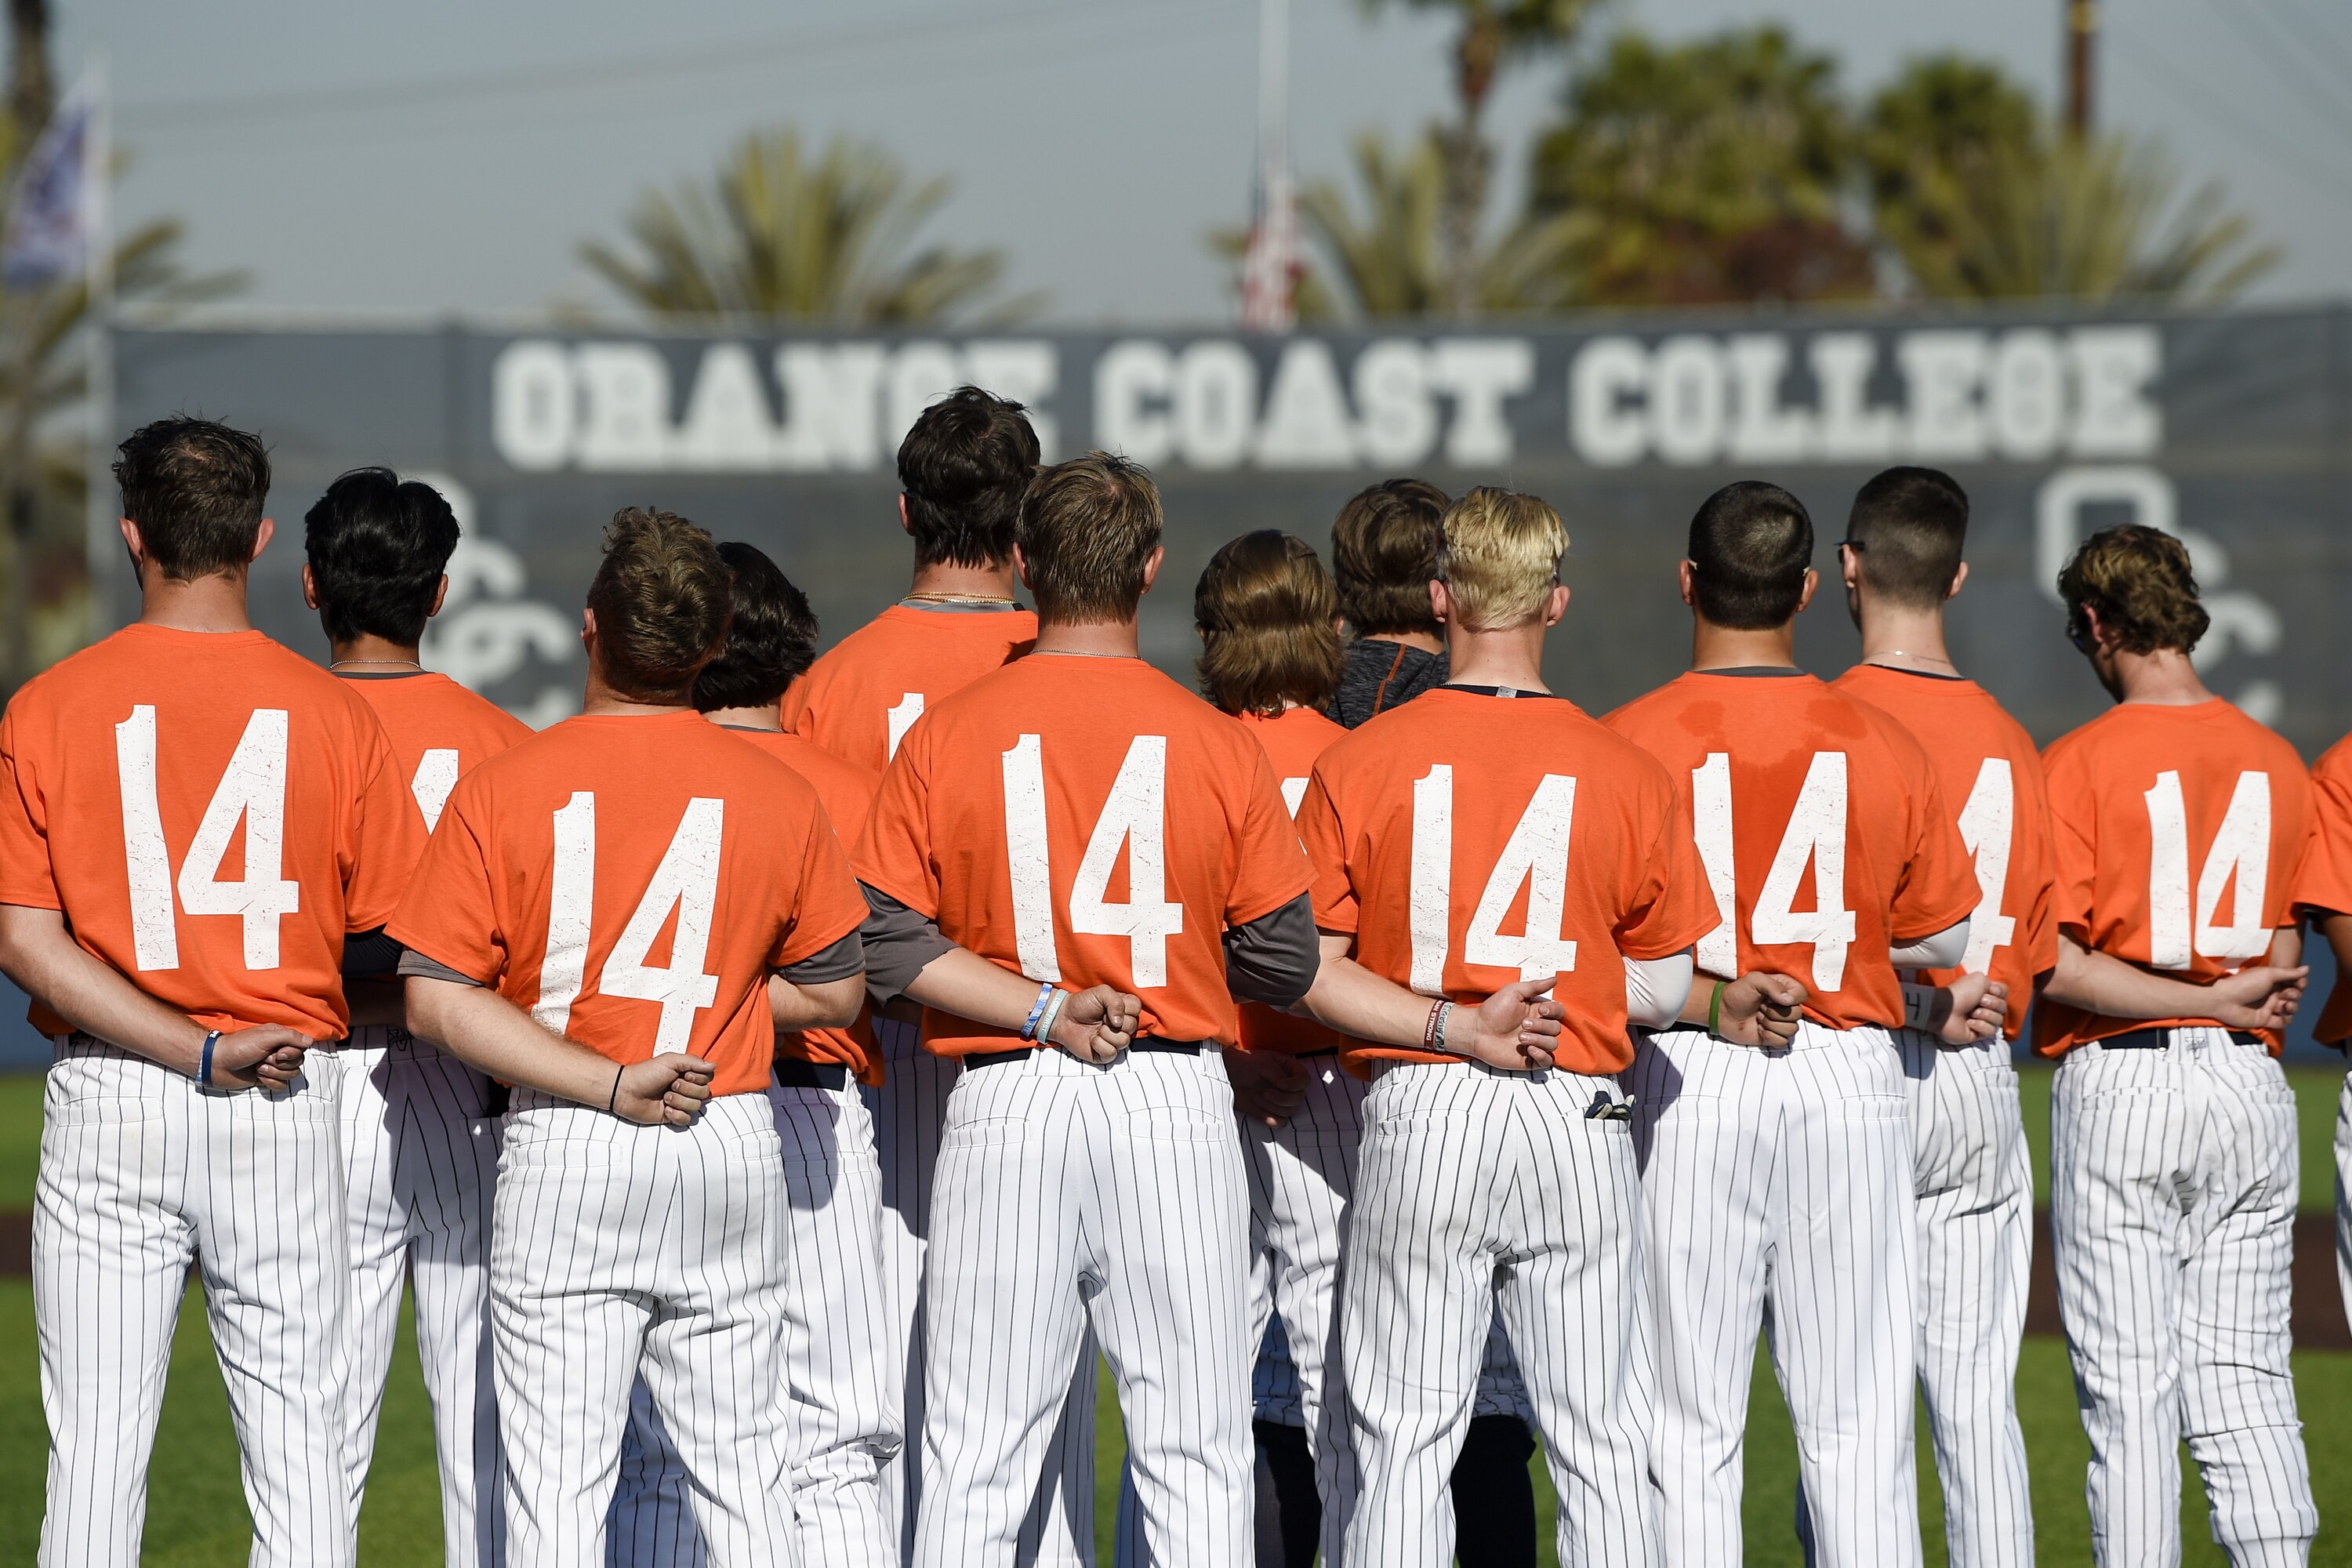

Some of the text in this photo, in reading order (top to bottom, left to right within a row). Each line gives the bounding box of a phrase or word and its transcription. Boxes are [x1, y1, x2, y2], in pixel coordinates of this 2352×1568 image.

[1094, 337, 1534, 466] COAST
[1571, 325, 2161, 466] COLLEGE
[114, 704, 299, 971] 14
[531, 791, 724, 1058] 14
[1001, 733, 1183, 988] 14
[1409, 764, 1577, 1000] 14
[1691, 751, 1857, 992] 14
[2143, 769, 2273, 975] 14
[1041, 996, 1062, 1033] LOVE FIRST
[1426, 1012, 1437, 1041] STRONG
